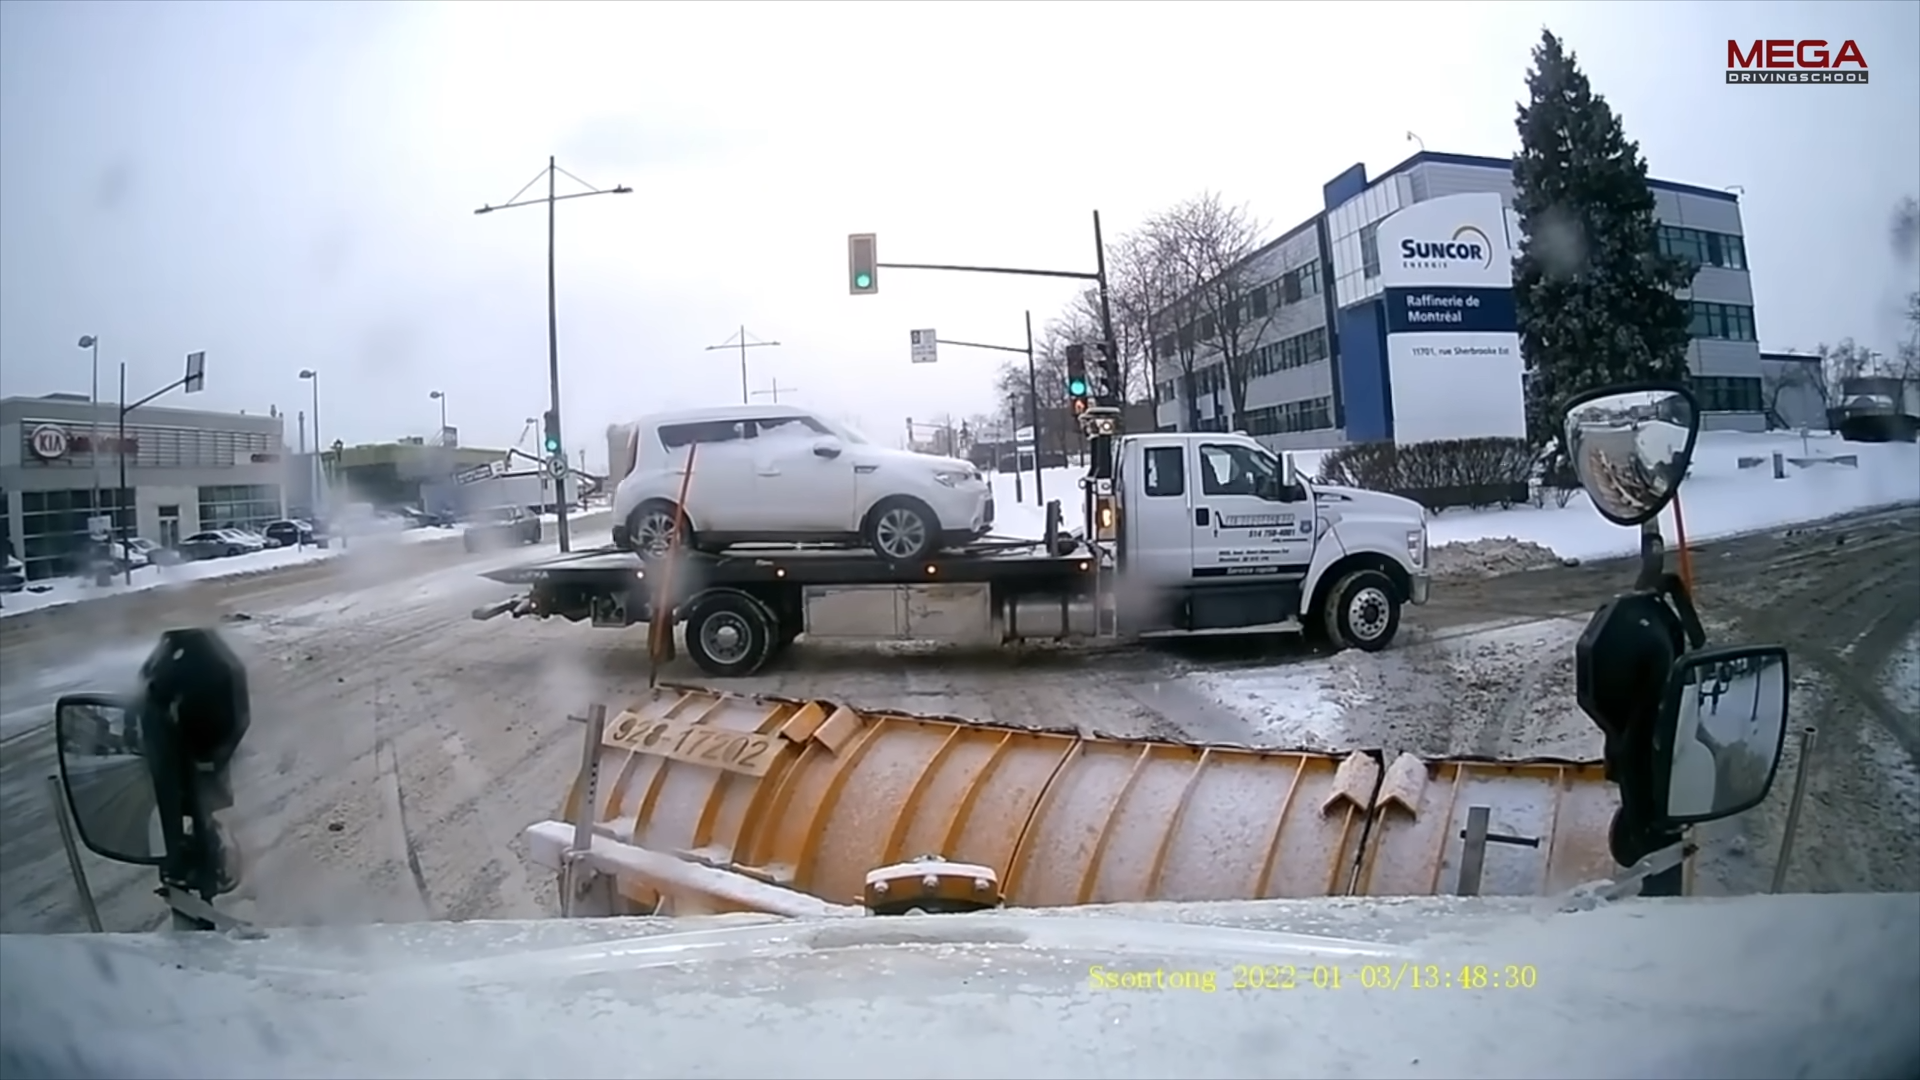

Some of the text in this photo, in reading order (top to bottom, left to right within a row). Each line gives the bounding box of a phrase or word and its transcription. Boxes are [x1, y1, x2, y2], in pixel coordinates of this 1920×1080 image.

[1401, 239, 1483, 260] SUNCOR
[1406, 295, 1481, 307] Raffinerie de
[1407, 310, 1463, 322] Montréal
[39, 433, 62, 451] KIA
